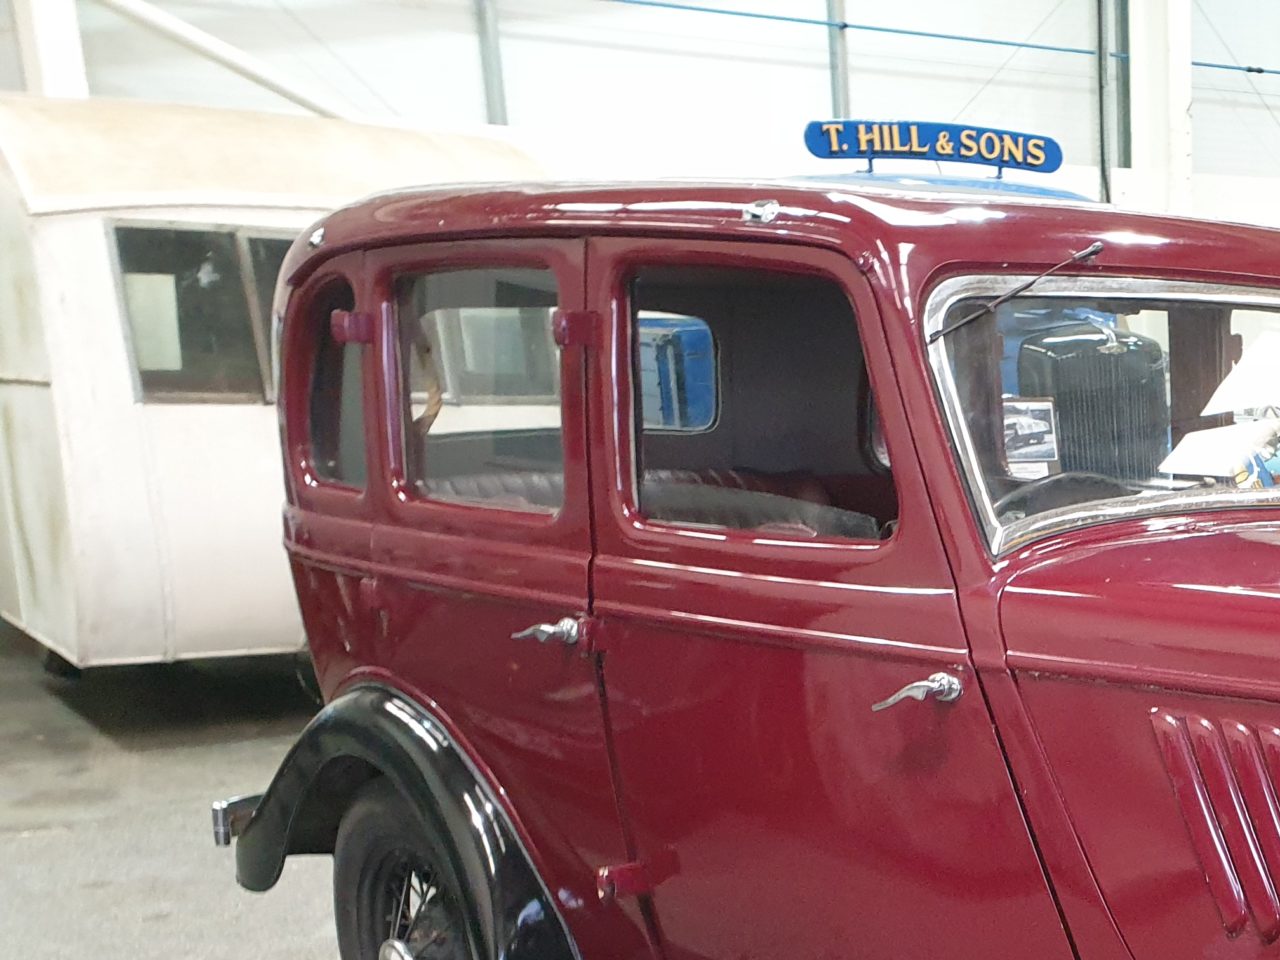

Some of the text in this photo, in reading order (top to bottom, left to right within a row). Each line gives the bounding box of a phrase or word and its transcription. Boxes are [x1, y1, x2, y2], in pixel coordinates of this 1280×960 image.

[821, 123, 1046, 166] T. HILL & SONS
